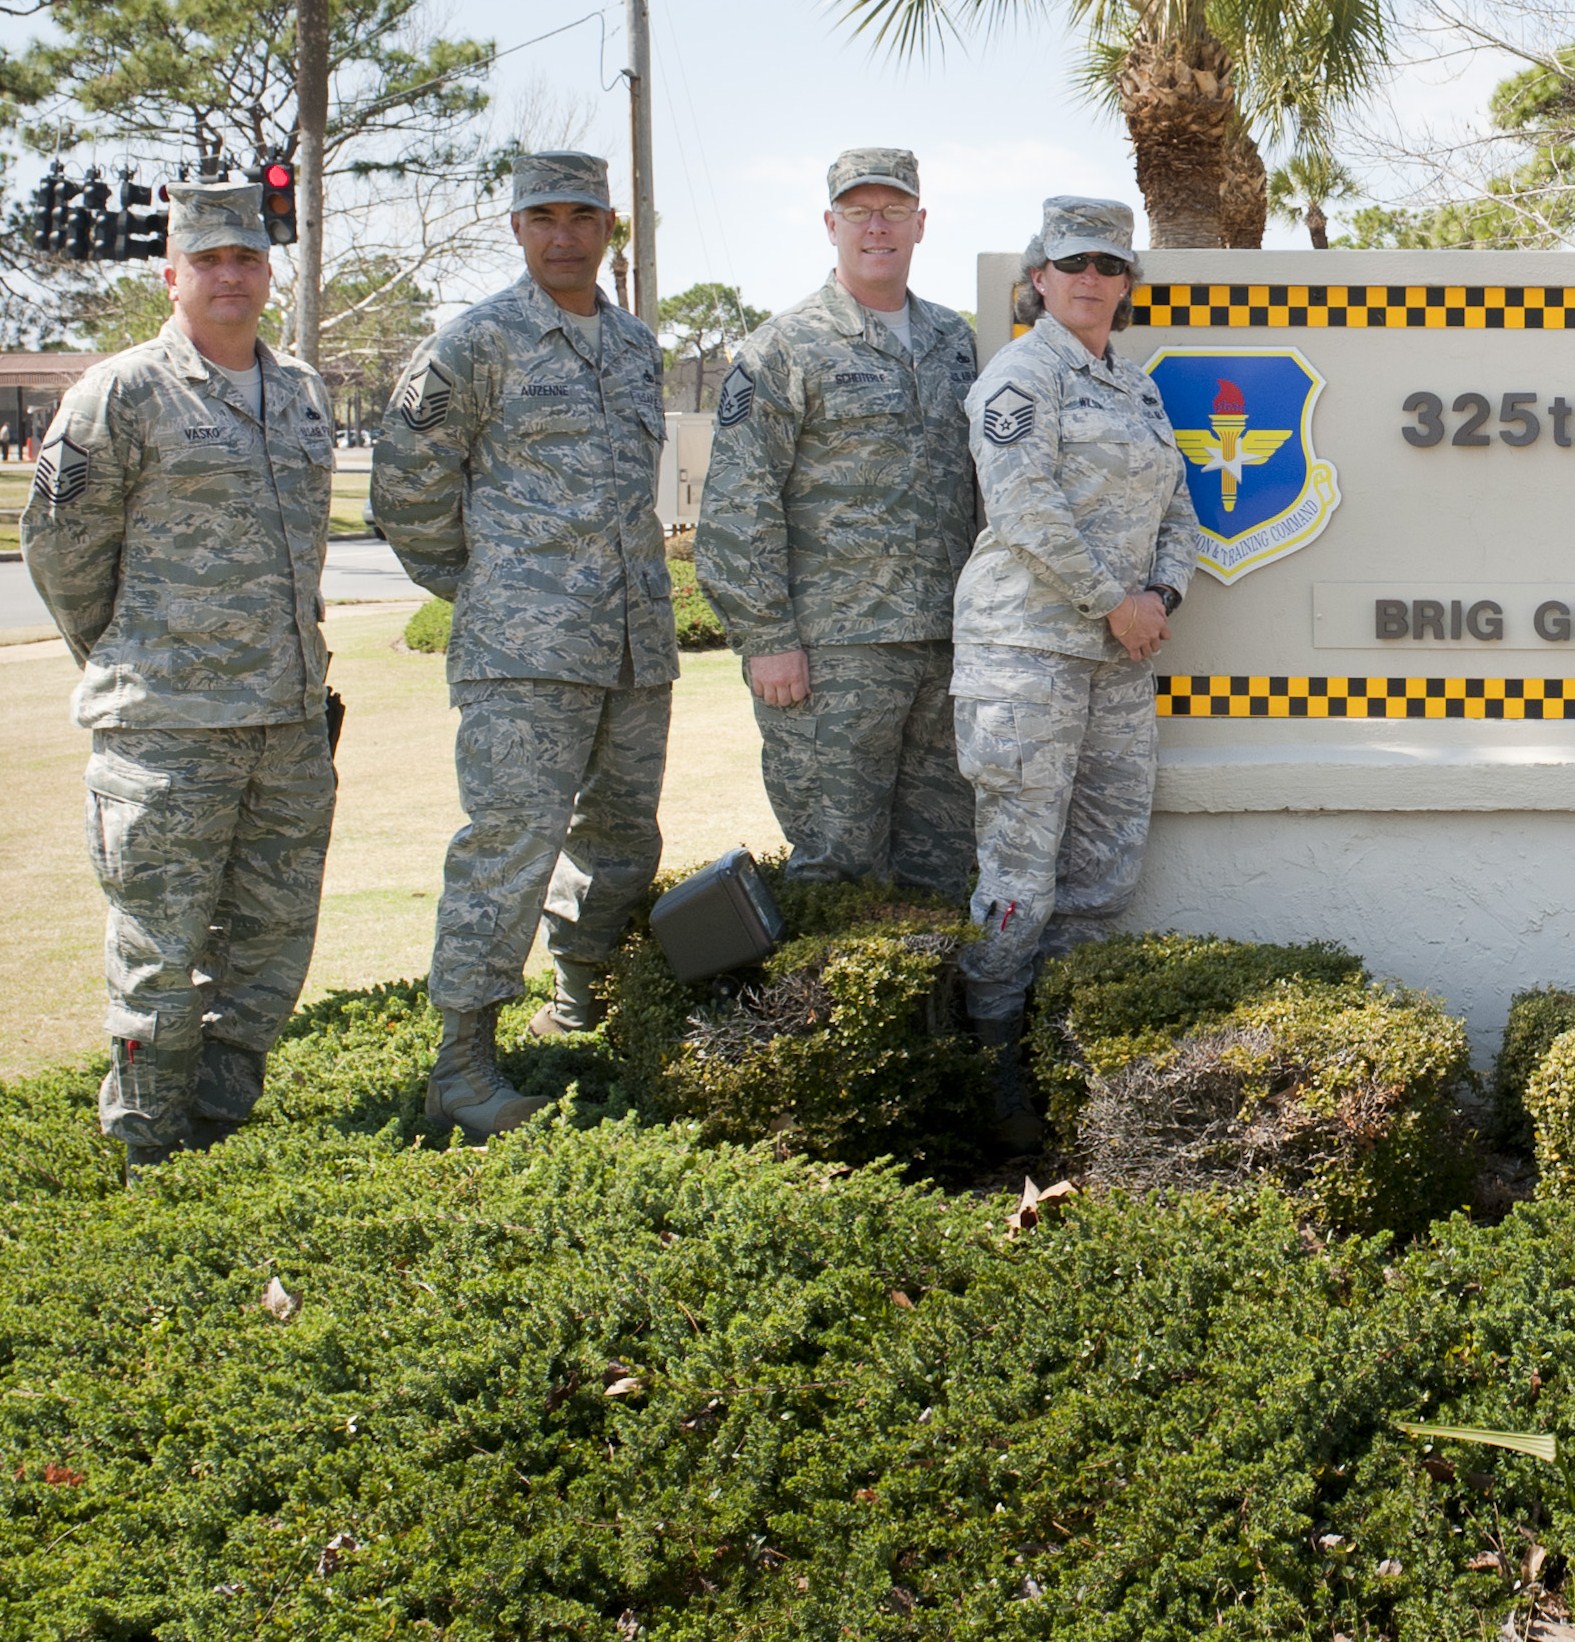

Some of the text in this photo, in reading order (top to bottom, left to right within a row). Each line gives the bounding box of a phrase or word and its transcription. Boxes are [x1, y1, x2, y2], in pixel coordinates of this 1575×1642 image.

[520, 385, 569, 397] AUZENNE
[184, 427, 221, 441] VASKO
[1211, 543, 1219, 560] &
[1220, 530, 1271, 567] TRAINING
[1269, 499, 1320, 542] COMMAND
[1375, 599, 1504, 642] BRIG
